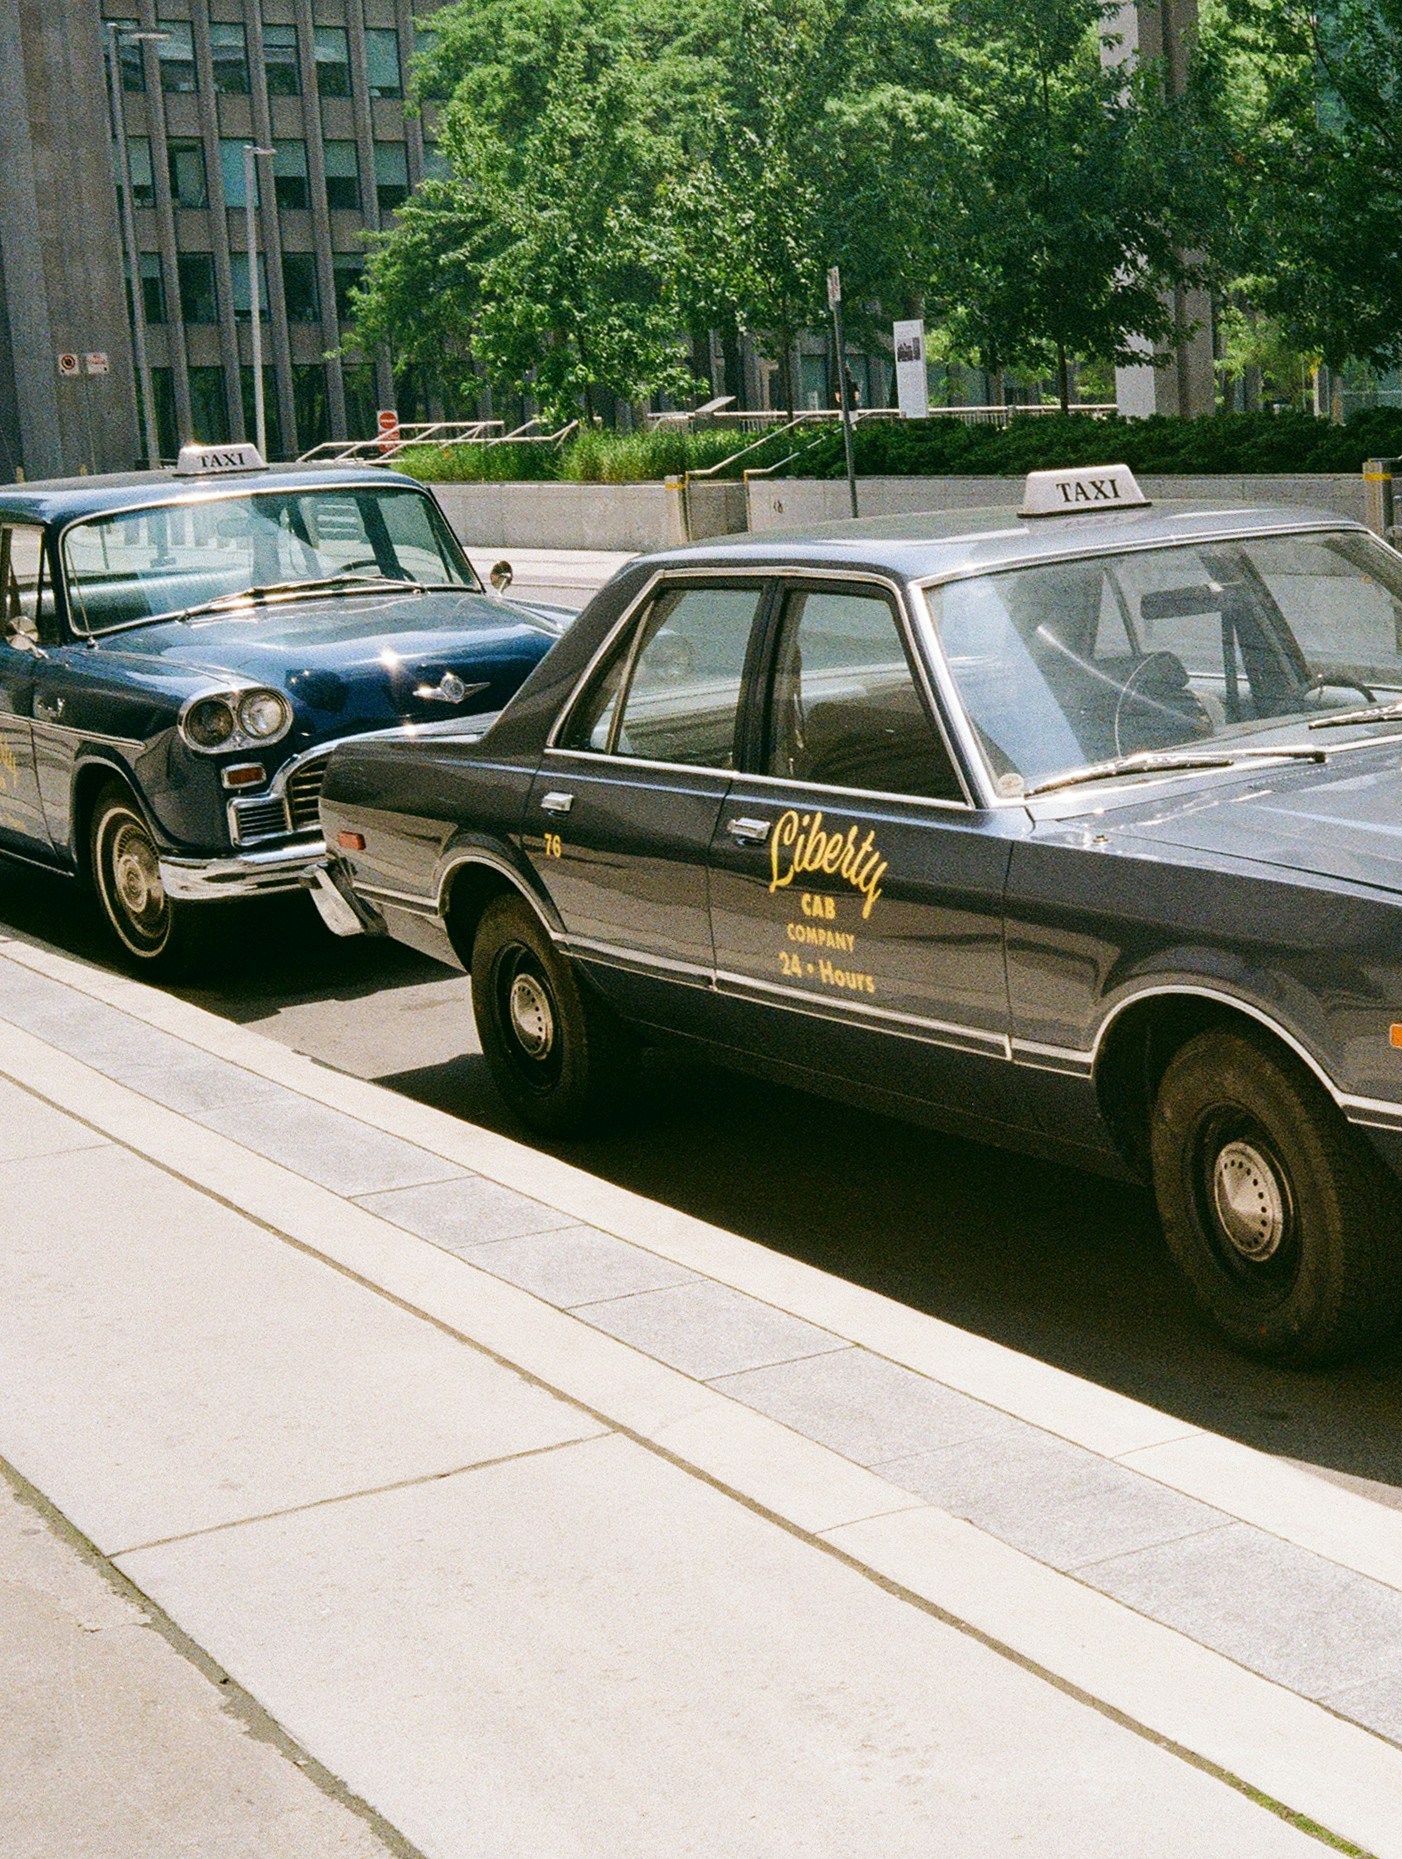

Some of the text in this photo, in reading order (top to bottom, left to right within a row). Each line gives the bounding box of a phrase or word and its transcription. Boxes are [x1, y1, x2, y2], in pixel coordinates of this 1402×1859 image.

[197, 452, 246, 468] TAXI
[1055, 478, 1122, 503] TAXI
[544, 832, 562, 858] 76
[769, 810, 889, 920] Liberty
[801, 892, 837, 920] CAB
[786, 922, 856, 953] COMPANY
[778, 950, 876, 994] 24 Hours
